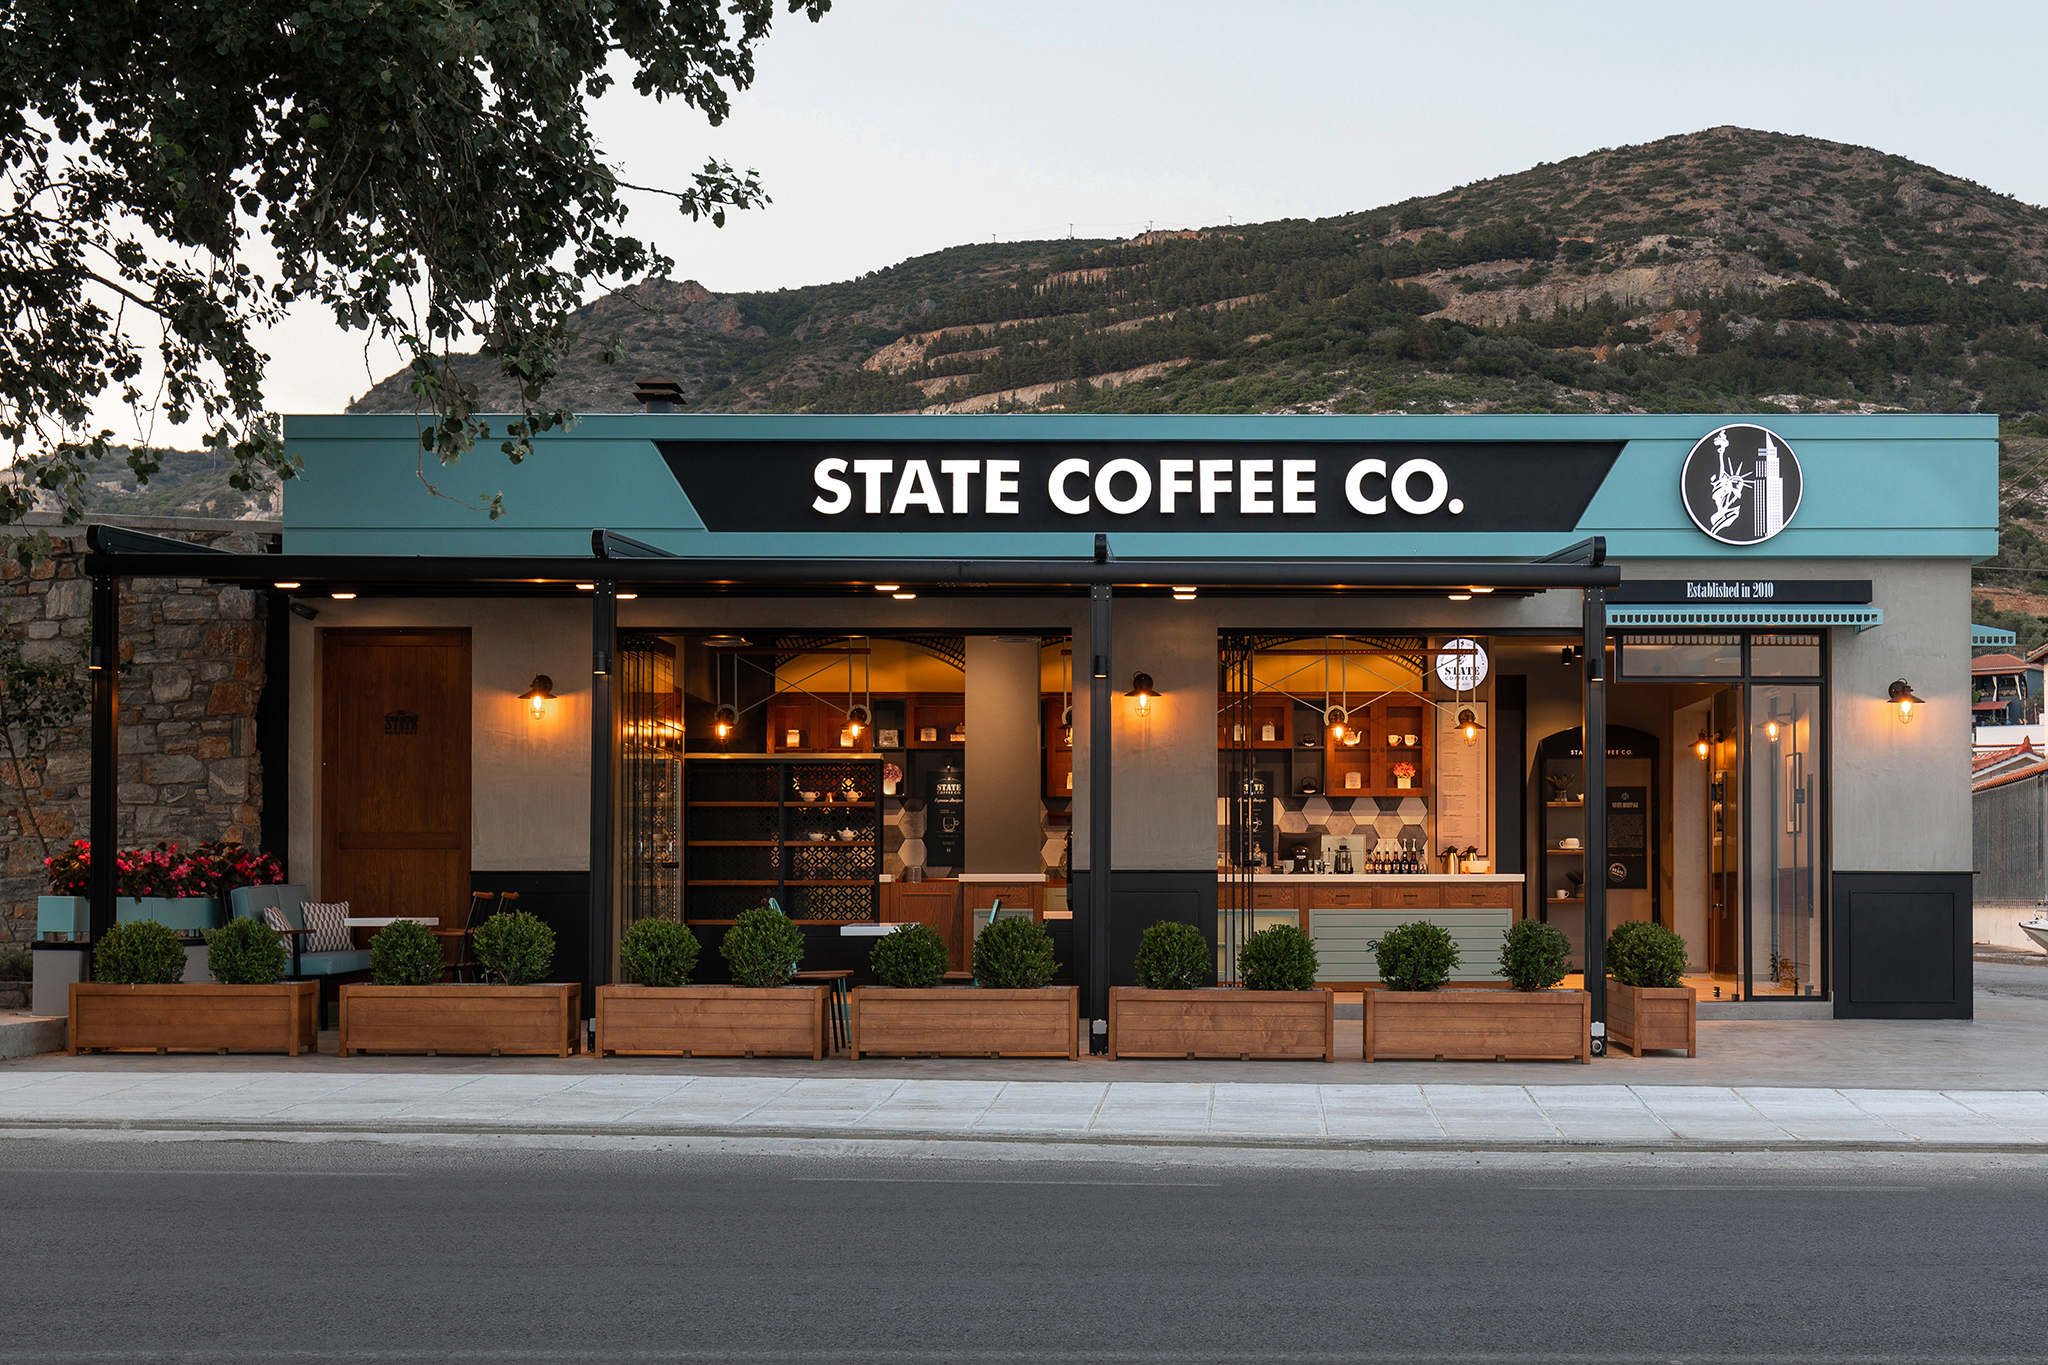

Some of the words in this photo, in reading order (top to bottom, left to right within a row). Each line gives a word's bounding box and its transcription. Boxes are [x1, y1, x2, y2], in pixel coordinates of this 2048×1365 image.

[812, 457, 1020, 515] STATE
[1048, 458, 1317, 515] COFFEE
[1345, 458, 1464, 515] CO.
[1686, 582, 1740, 598] Established
[1741, 582, 1751, 598] in
[1752, 581, 1774, 598] 2010
[1444, 666, 1480, 676] STATE
[385, 716, 418, 730] STATE
[936, 783, 962, 791] STATE
